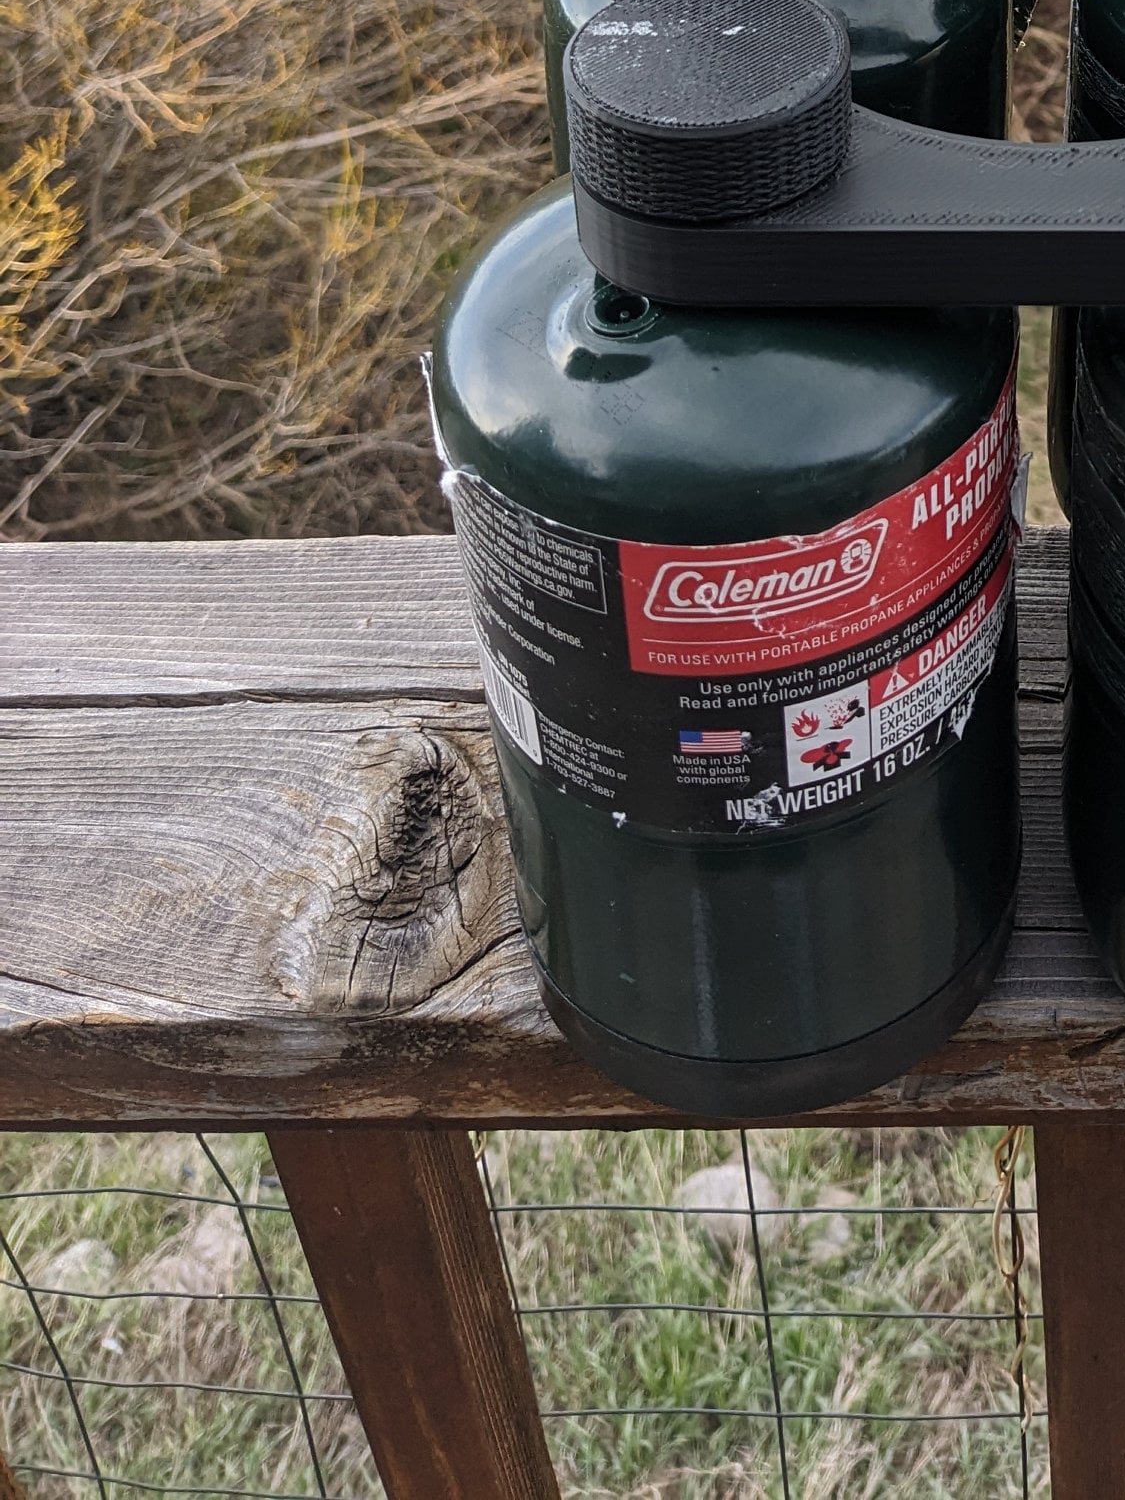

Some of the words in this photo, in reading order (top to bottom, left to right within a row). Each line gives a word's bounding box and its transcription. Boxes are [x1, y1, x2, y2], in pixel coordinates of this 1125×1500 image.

[497, 536, 515, 555] other
[516, 548, 568, 583] reproductive
[569, 574, 597, 592] harm.
[501, 523, 527, 550] known
[537, 544, 551, 562] the
[553, 554, 577, 573] State
[579, 564, 589, 576] of
[537, 531, 545, 546] to
[547, 538, 594, 563] chemicals
[508, 572, 524, 592] Inc.
[526, 599, 535, 612] of
[648, 651, 677, 665] FOR
[680, 654, 711, 665] USE
[714, 651, 756, 665] WITH
[761, 633, 838, 660] PORTABLE
[840, 604, 904, 638] PROPANE
[906, 545, 971, 607] APPLIANCES
[972, 538, 979, 551] &
[668, 558, 836, 607] Coleman
[501, 593, 520, 615] used
[521, 609, 545, 630] under
[547, 623, 584, 649] license.
[508, 624, 555, 666] Corporation
[680, 696, 722, 709] Read
[727, 695, 757, 708] and
[762, 685, 814, 705] follow
[818, 654, 892, 690] important
[895, 625, 935, 657] safety
[938, 578, 983, 628] warnings
[700, 681, 733, 695] Use
[737, 676, 773, 695] only
[777, 669, 814, 687] with
[818, 634, 900, 678] appliances
[903, 590, 956, 638] designed
[959, 576, 972, 599] for
[918, 595, 986, 677] DANGER
[880, 668, 943, 721] EXTREMELY
[945, 612, 994, 677] FLAMMABLE
[880, 685, 942, 736] EXPLOSION
[944, 649, 980, 692] HAZARD
[880, 706, 937, 751] PRESSURE
[944, 662, 979, 707] CARBON
[538, 712, 583, 745] Emergency
[585, 738, 625, 759] Contact:
[539, 723, 587, 755] CHEMTREC
[589, 751, 599, 761] at
[542, 735, 616, 778] 1-800-424-9300
[617, 773, 628, 781] or
[543, 745, 594, 780] International
[546, 757, 616, 799] 1-703-527-3887
[673, 755, 707, 766] Made
[710, 756, 719, 765] in
[723, 755, 751, 765] USA
[676, 774, 751, 785] components
[679, 765, 707, 775] with
[709, 765, 746, 776] global
[726, 798, 770, 821] NET
[778, 768, 865, 815] WEIGHT
[873, 751, 896, 782] 16
[902, 733, 931, 766] OZ.
